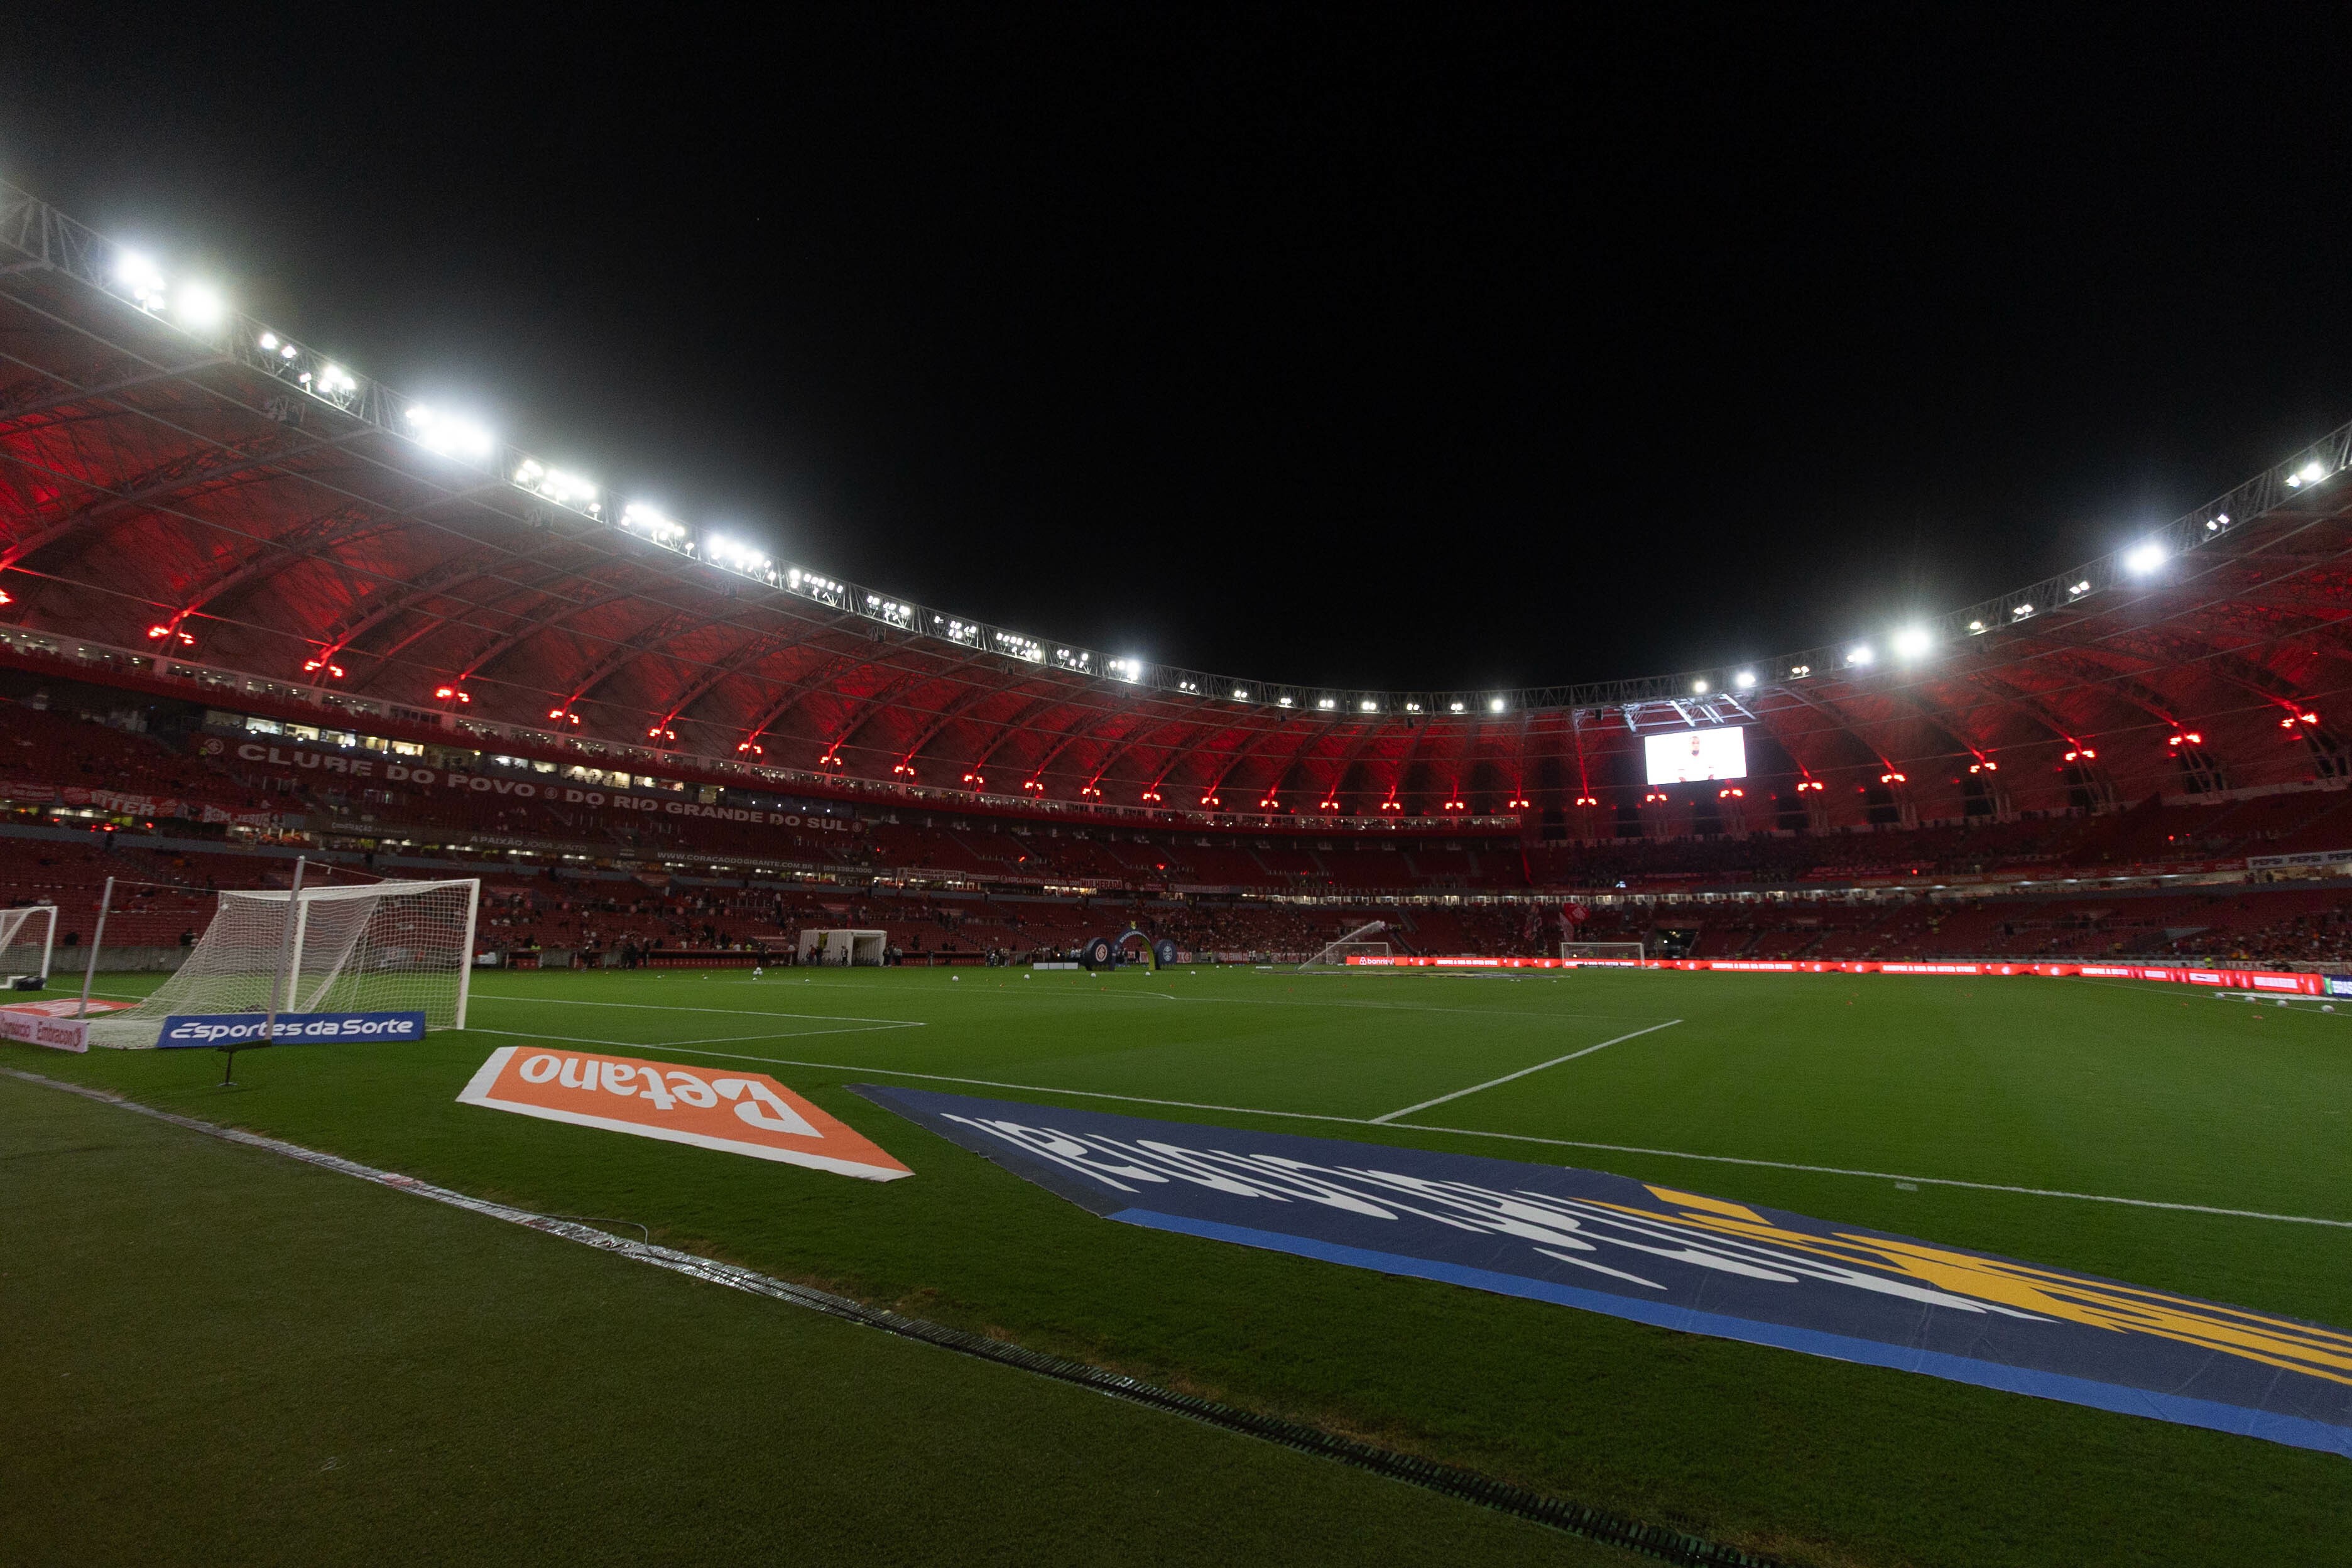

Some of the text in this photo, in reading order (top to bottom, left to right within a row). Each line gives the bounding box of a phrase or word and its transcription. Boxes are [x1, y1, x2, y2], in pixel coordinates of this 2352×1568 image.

[239, 743, 536, 797] CLUBE DO POVO
[565, 789, 849, 832] DO RIO GRANDE DO SUL
[469, 834, 479, 843] A
[2289, 854, 2321, 863] PEPSI
[1081, 879, 1121, 890] MULHERADA
[170, 1018, 412, 1042] Esportes da Sorte
